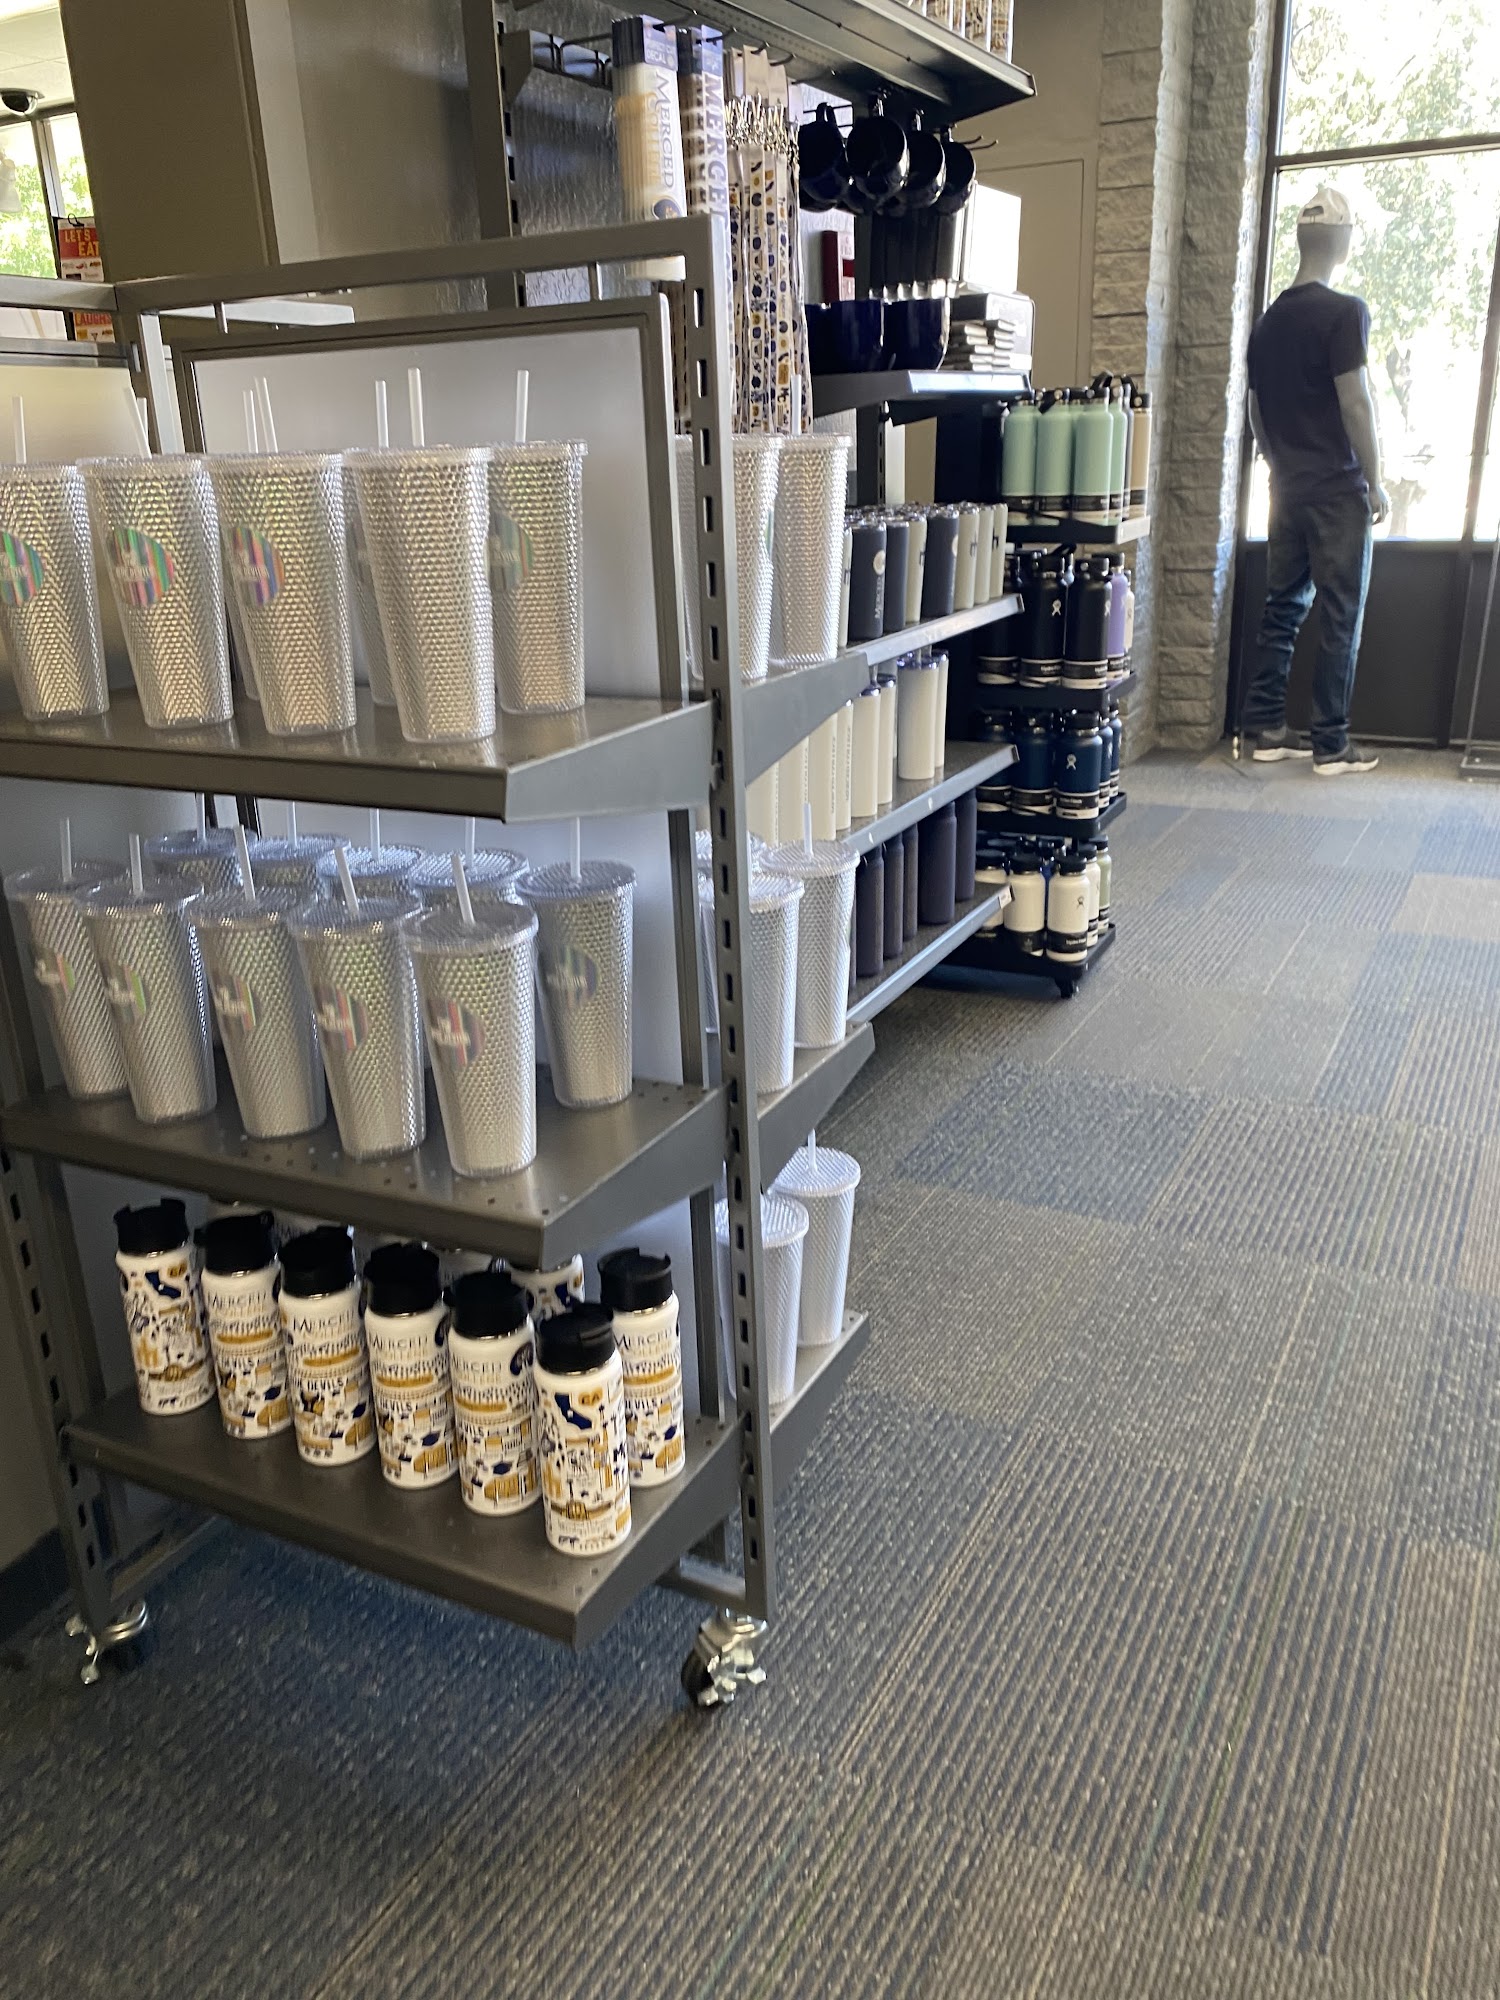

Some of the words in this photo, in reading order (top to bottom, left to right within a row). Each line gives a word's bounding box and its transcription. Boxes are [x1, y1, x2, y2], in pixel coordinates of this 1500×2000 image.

[646, 50, 667, 65] DECAL
[655, 71, 675, 189] MERCED
[78, 241, 100, 257] EAT
[292, 1309, 356, 1334] MERCED
[613, 1327, 673, 1351] MERCED
